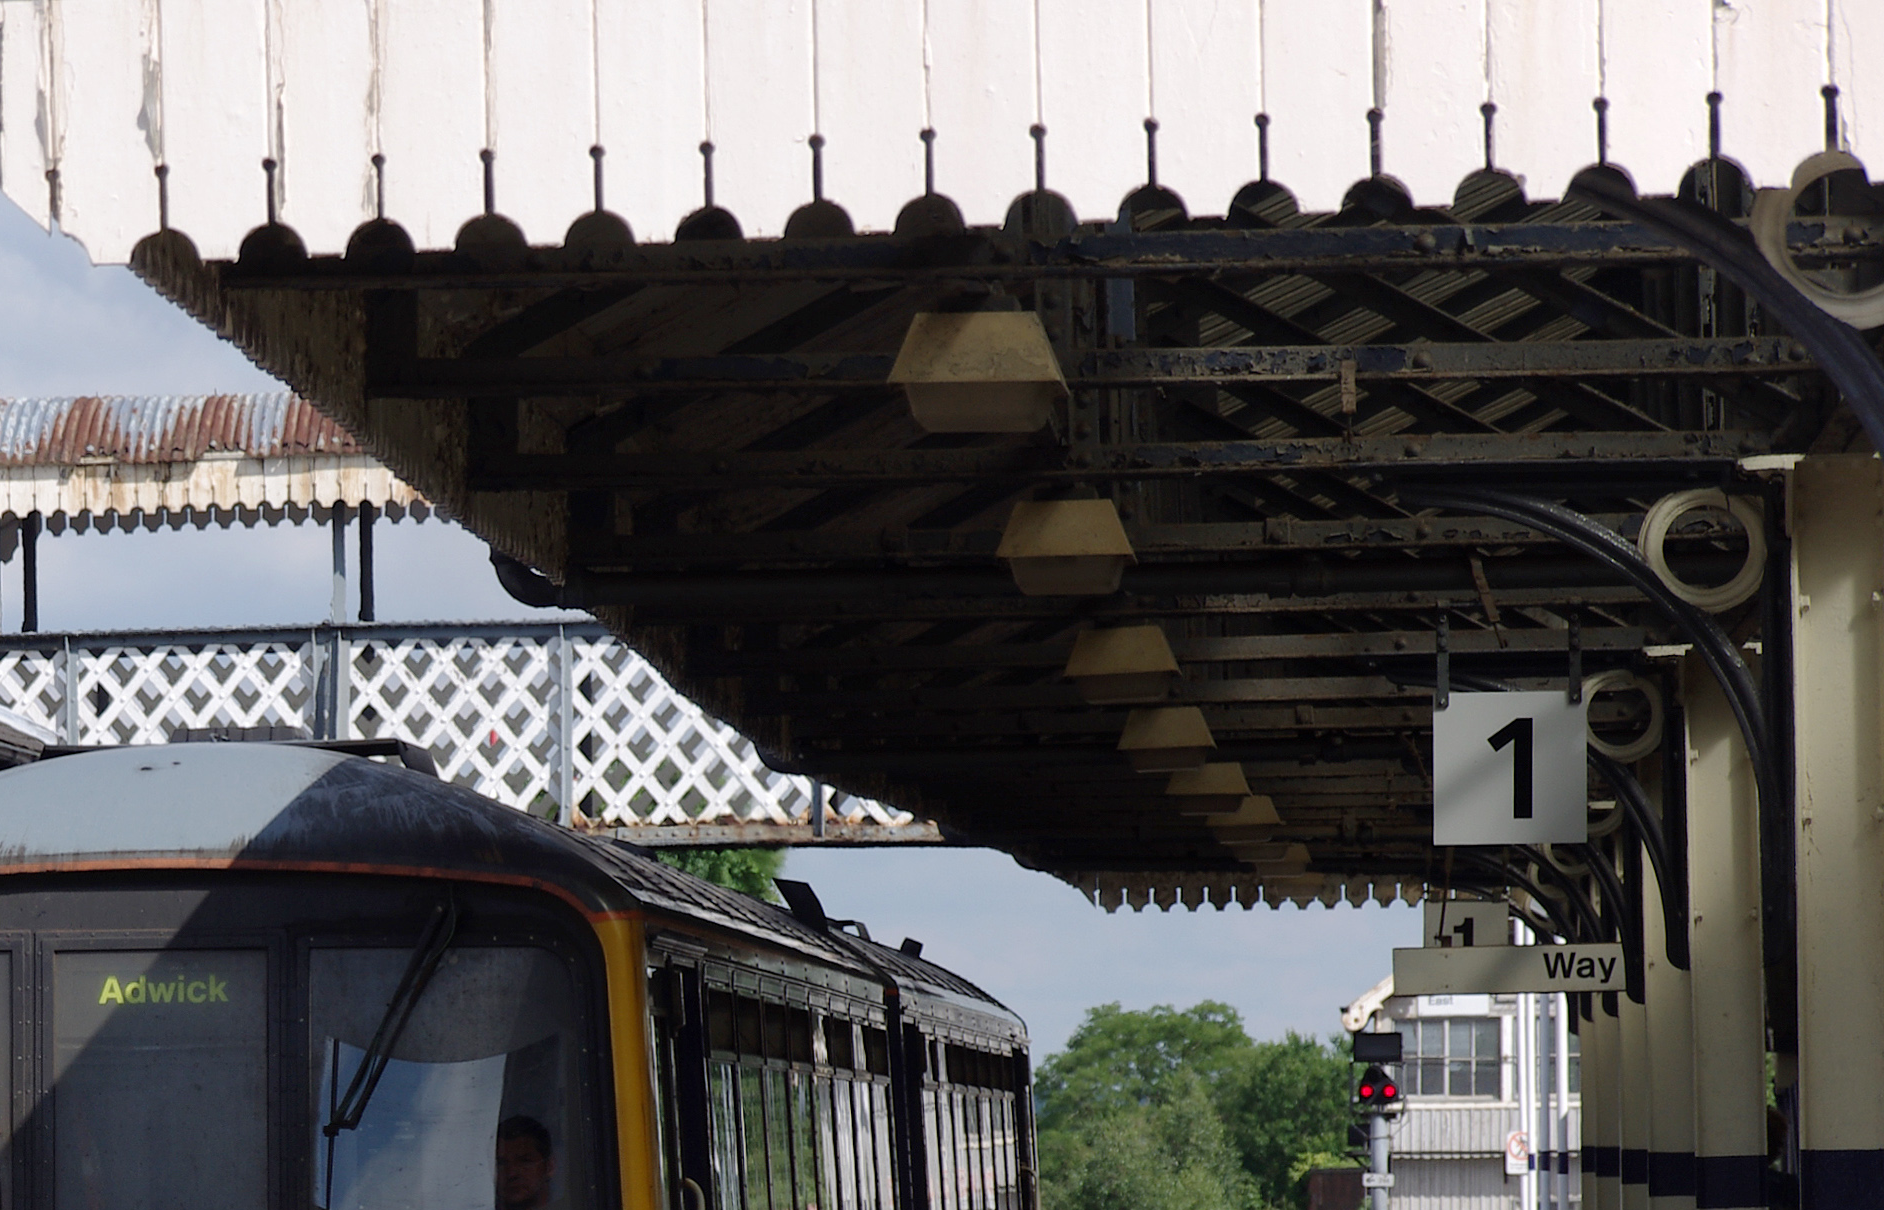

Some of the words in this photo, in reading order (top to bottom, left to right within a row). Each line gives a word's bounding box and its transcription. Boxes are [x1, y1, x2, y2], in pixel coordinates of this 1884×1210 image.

[1487, 717, 1534, 819] 1
[1454, 917, 1474, 946] 1
[1543, 952, 1616, 983] Way
[98, 975, 229, 1005] Adwick
